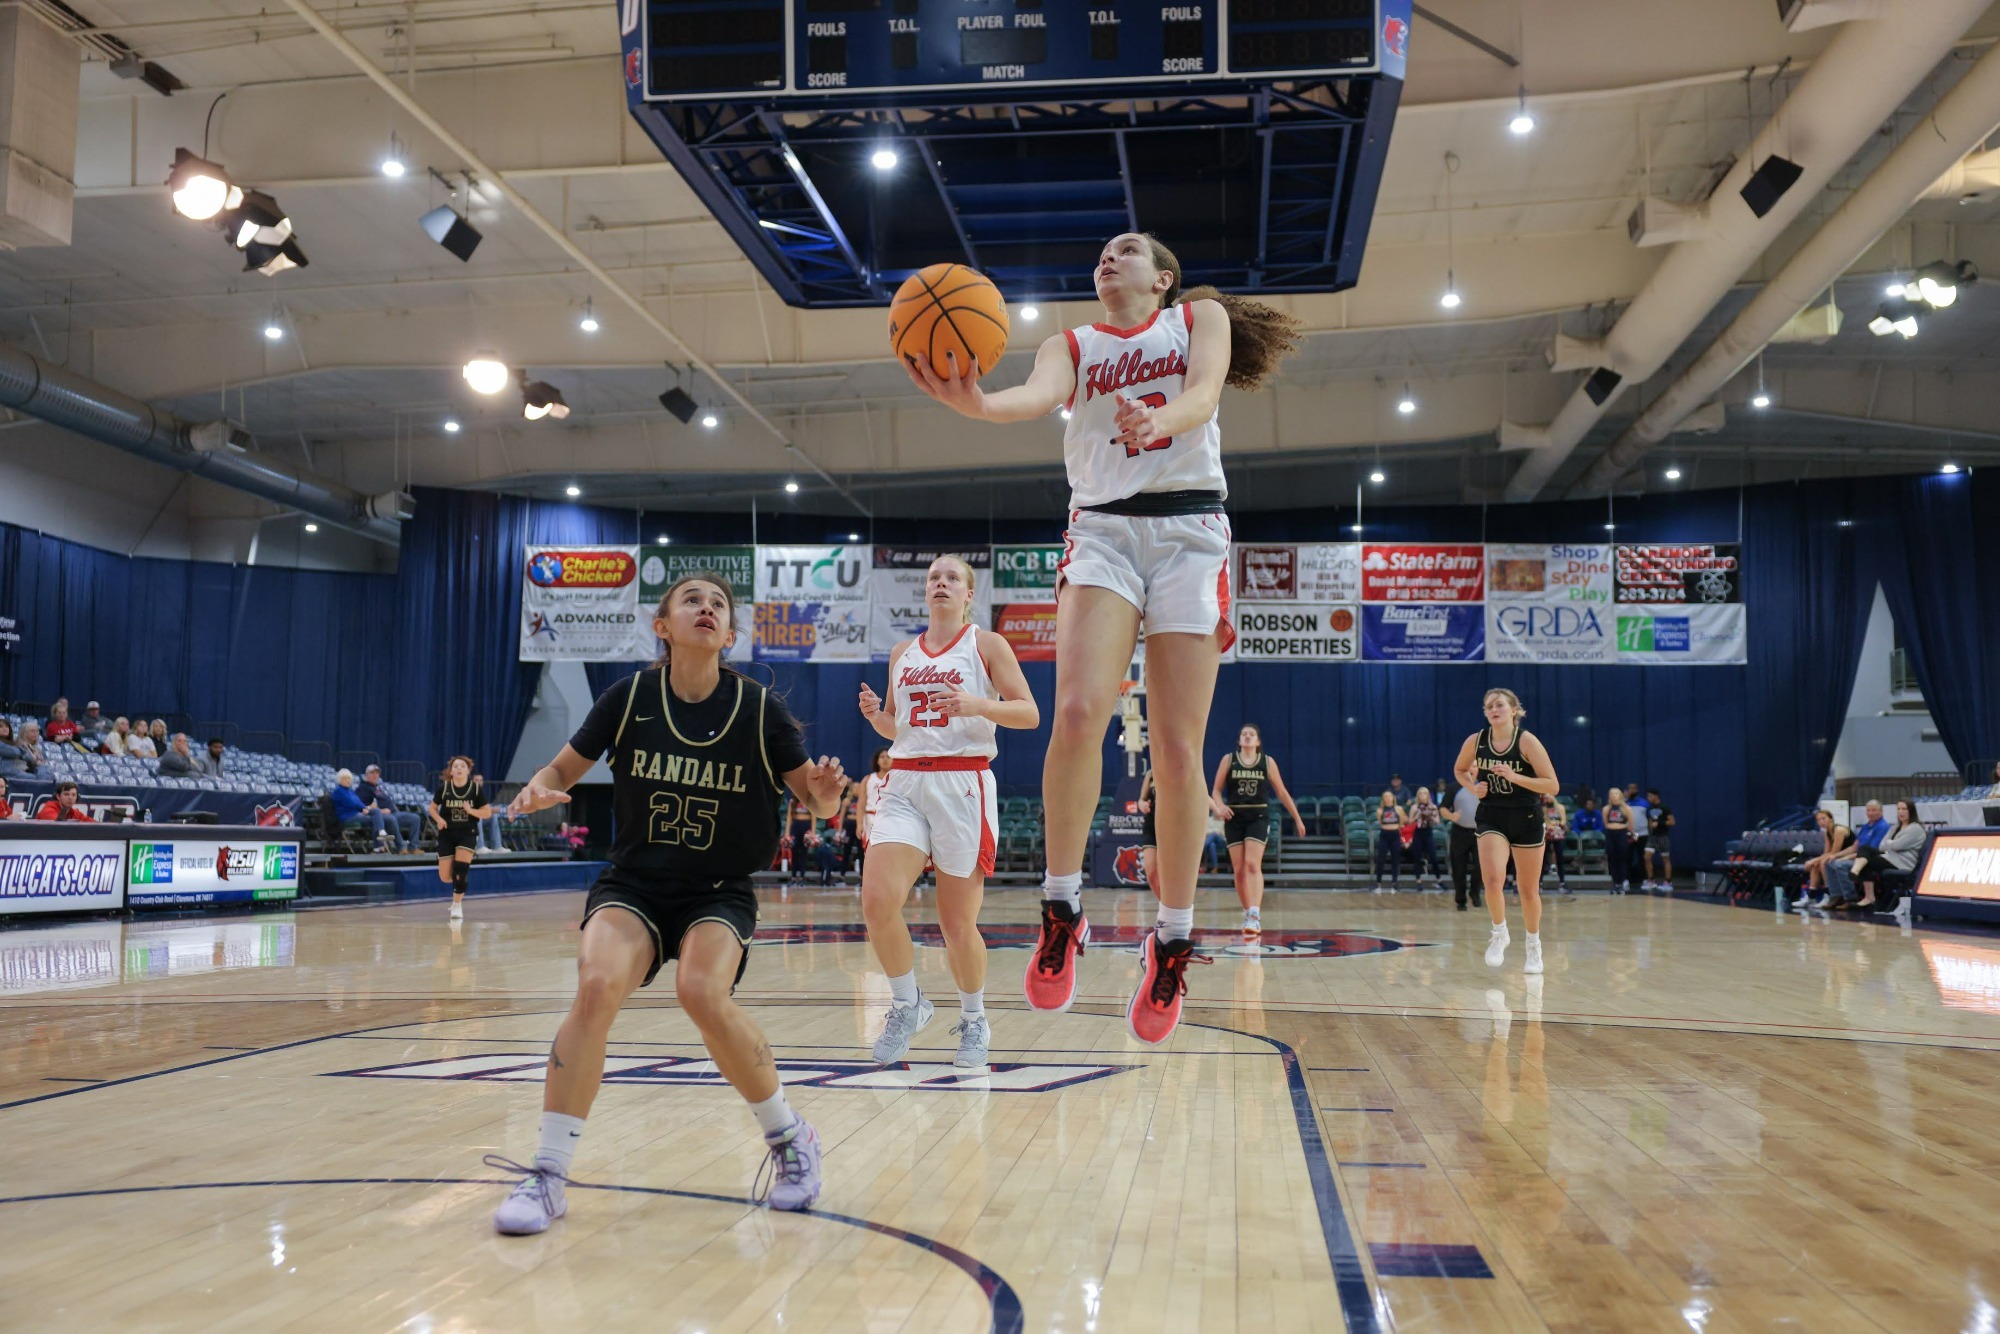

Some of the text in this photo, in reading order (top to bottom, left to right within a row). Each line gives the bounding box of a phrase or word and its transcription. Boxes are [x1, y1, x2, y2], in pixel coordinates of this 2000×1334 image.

[957, 13, 1047, 30] PLAYER FOUL
[1088, 10, 1122, 24] T.O.L.
[1161, 6, 1202, 22] FOULS
[807, 22, 846, 37] FOULS
[888, 18, 921, 33] T.O.L.
[982, 65, 1025, 80] MATCH
[1162, 57, 1204, 73] SCORE
[807, 72, 848, 87] SCORE
[1085, 347, 1188, 402] Hillcats
[1551, 545, 1600, 559] Shop
[562, 557, 627, 571] Charlie's
[668, 555, 751, 570] EXECUTIVE
[998, 552, 1039, 571] RCB
[1567, 561, 1609, 573] Dine
[562, 571, 623, 584] Chicken
[766, 558, 861, 589] TTCU
[1551, 572, 1591, 586] Stay
[1569, 587, 1609, 602] Play
[554, 613, 636, 623] ADVANCED
[753, 603, 790, 623] GET
[1241, 614, 1318, 631] ROBSON
[1497, 606, 1603, 637] GRDA
[752, 623, 816, 646] HIRED
[1241, 638, 1352, 655] PROPERTIES
[1497, 650, 1604, 660] wwwgrda.com
[898, 665, 964, 688] Hillcats
[630, 749, 746, 793] RANDALL
[1231, 769, 1265, 779] RANDALL
[445, 799, 474, 808] RANDL
[648, 791, 719, 851] 25
[180, 857, 197, 869] OFFICIAL
[197, 857, 208, 869] HOTEL
[229, 850, 257, 868] RSU
